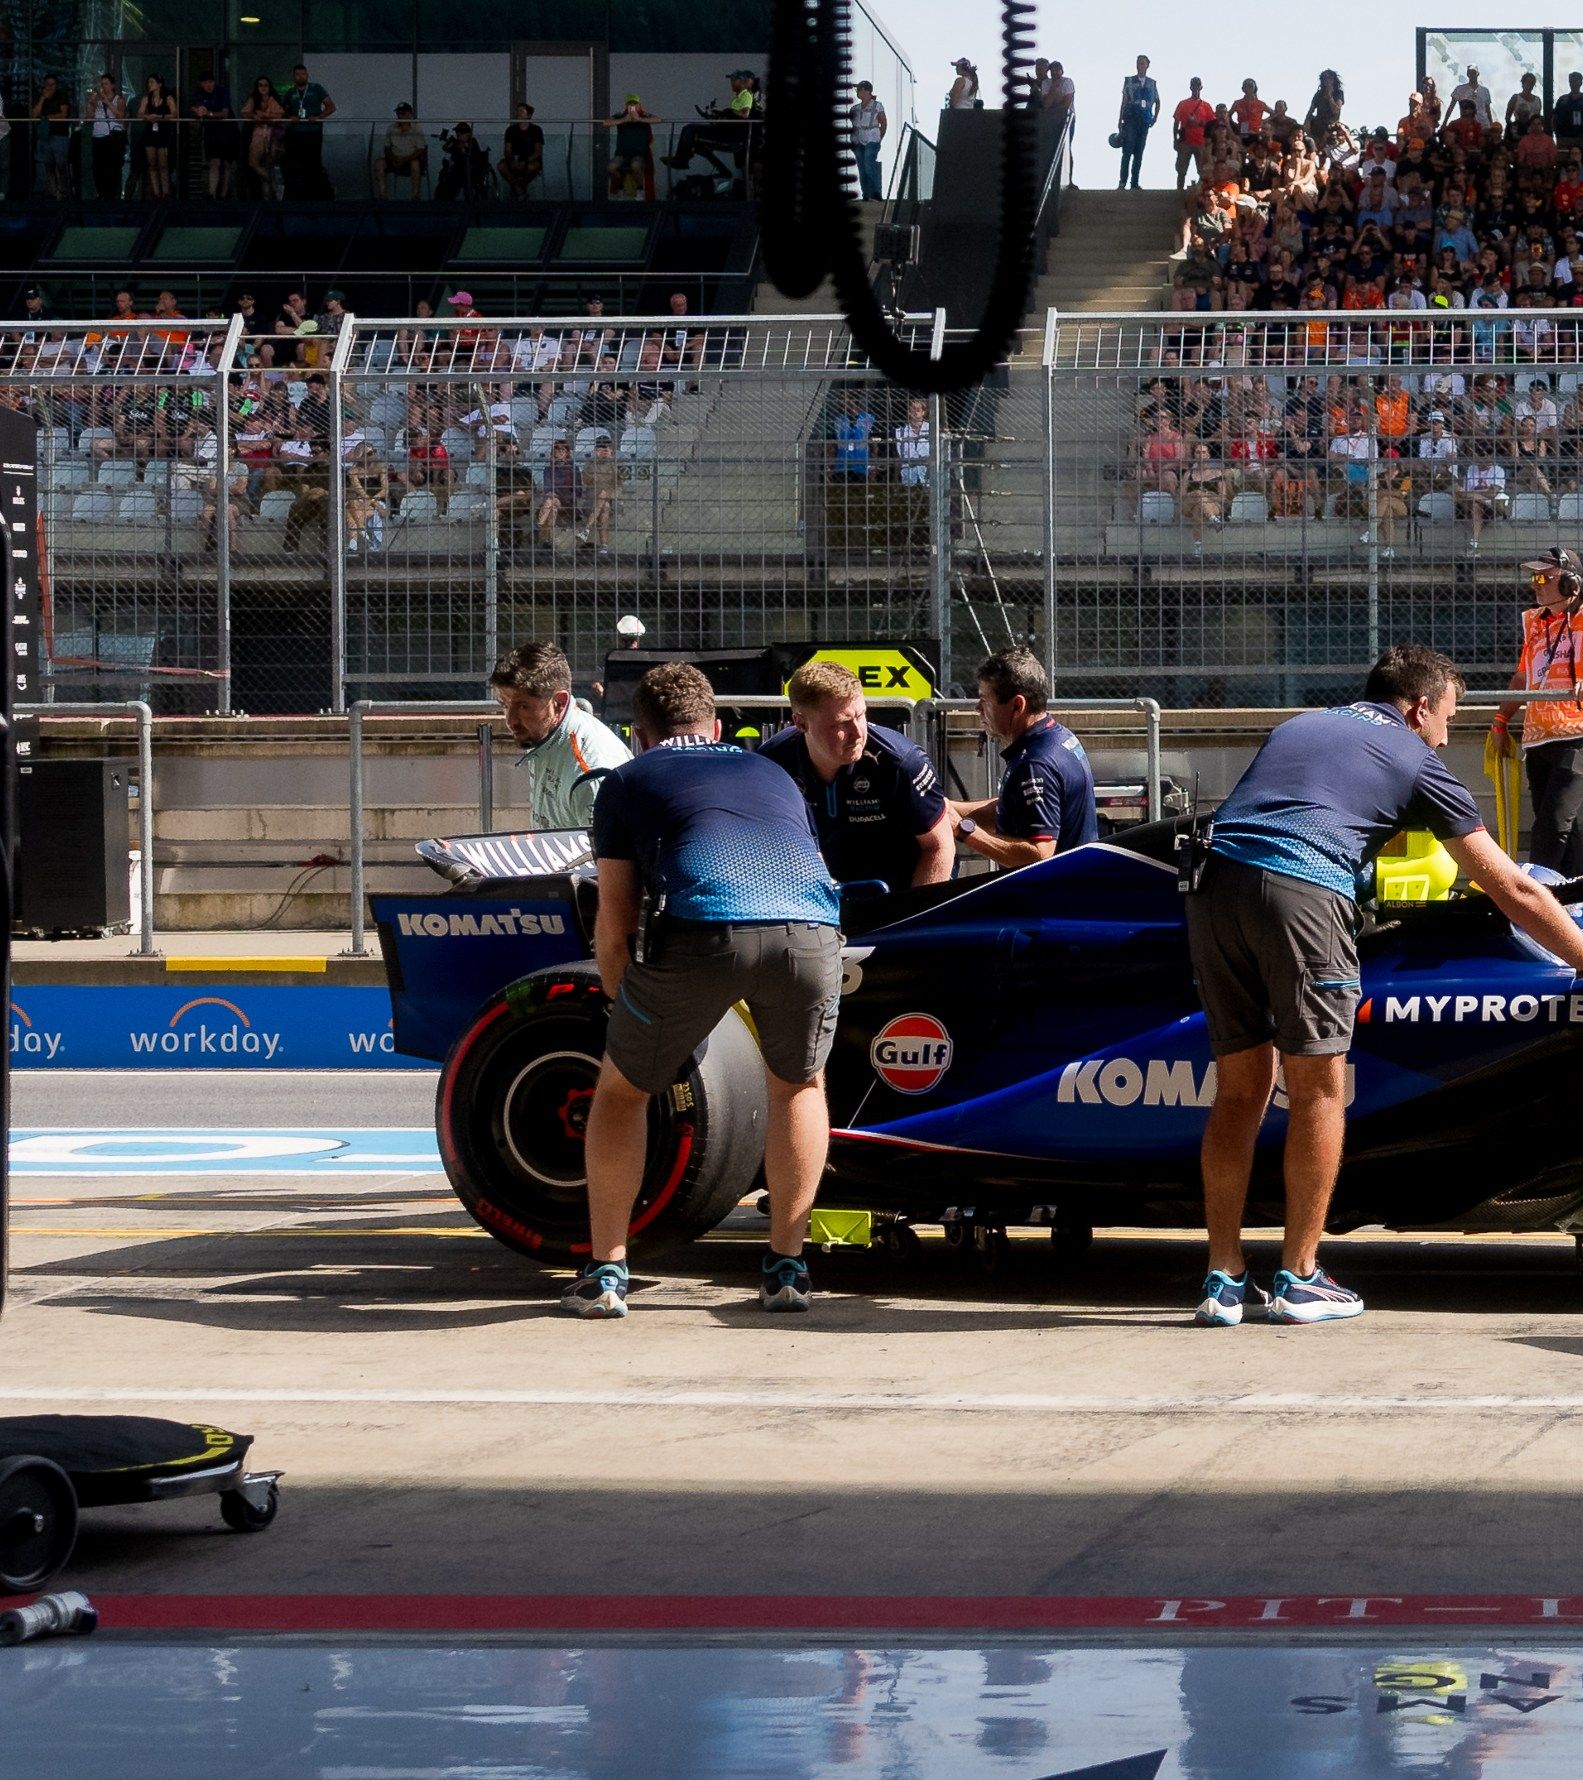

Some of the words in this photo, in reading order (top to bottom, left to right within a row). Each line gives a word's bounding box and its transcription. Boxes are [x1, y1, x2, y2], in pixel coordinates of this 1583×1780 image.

[858, 665, 911, 688] EX
[397, 908, 566, 936] KOMATSU
[875, 1040, 948, 1065] Gulf
